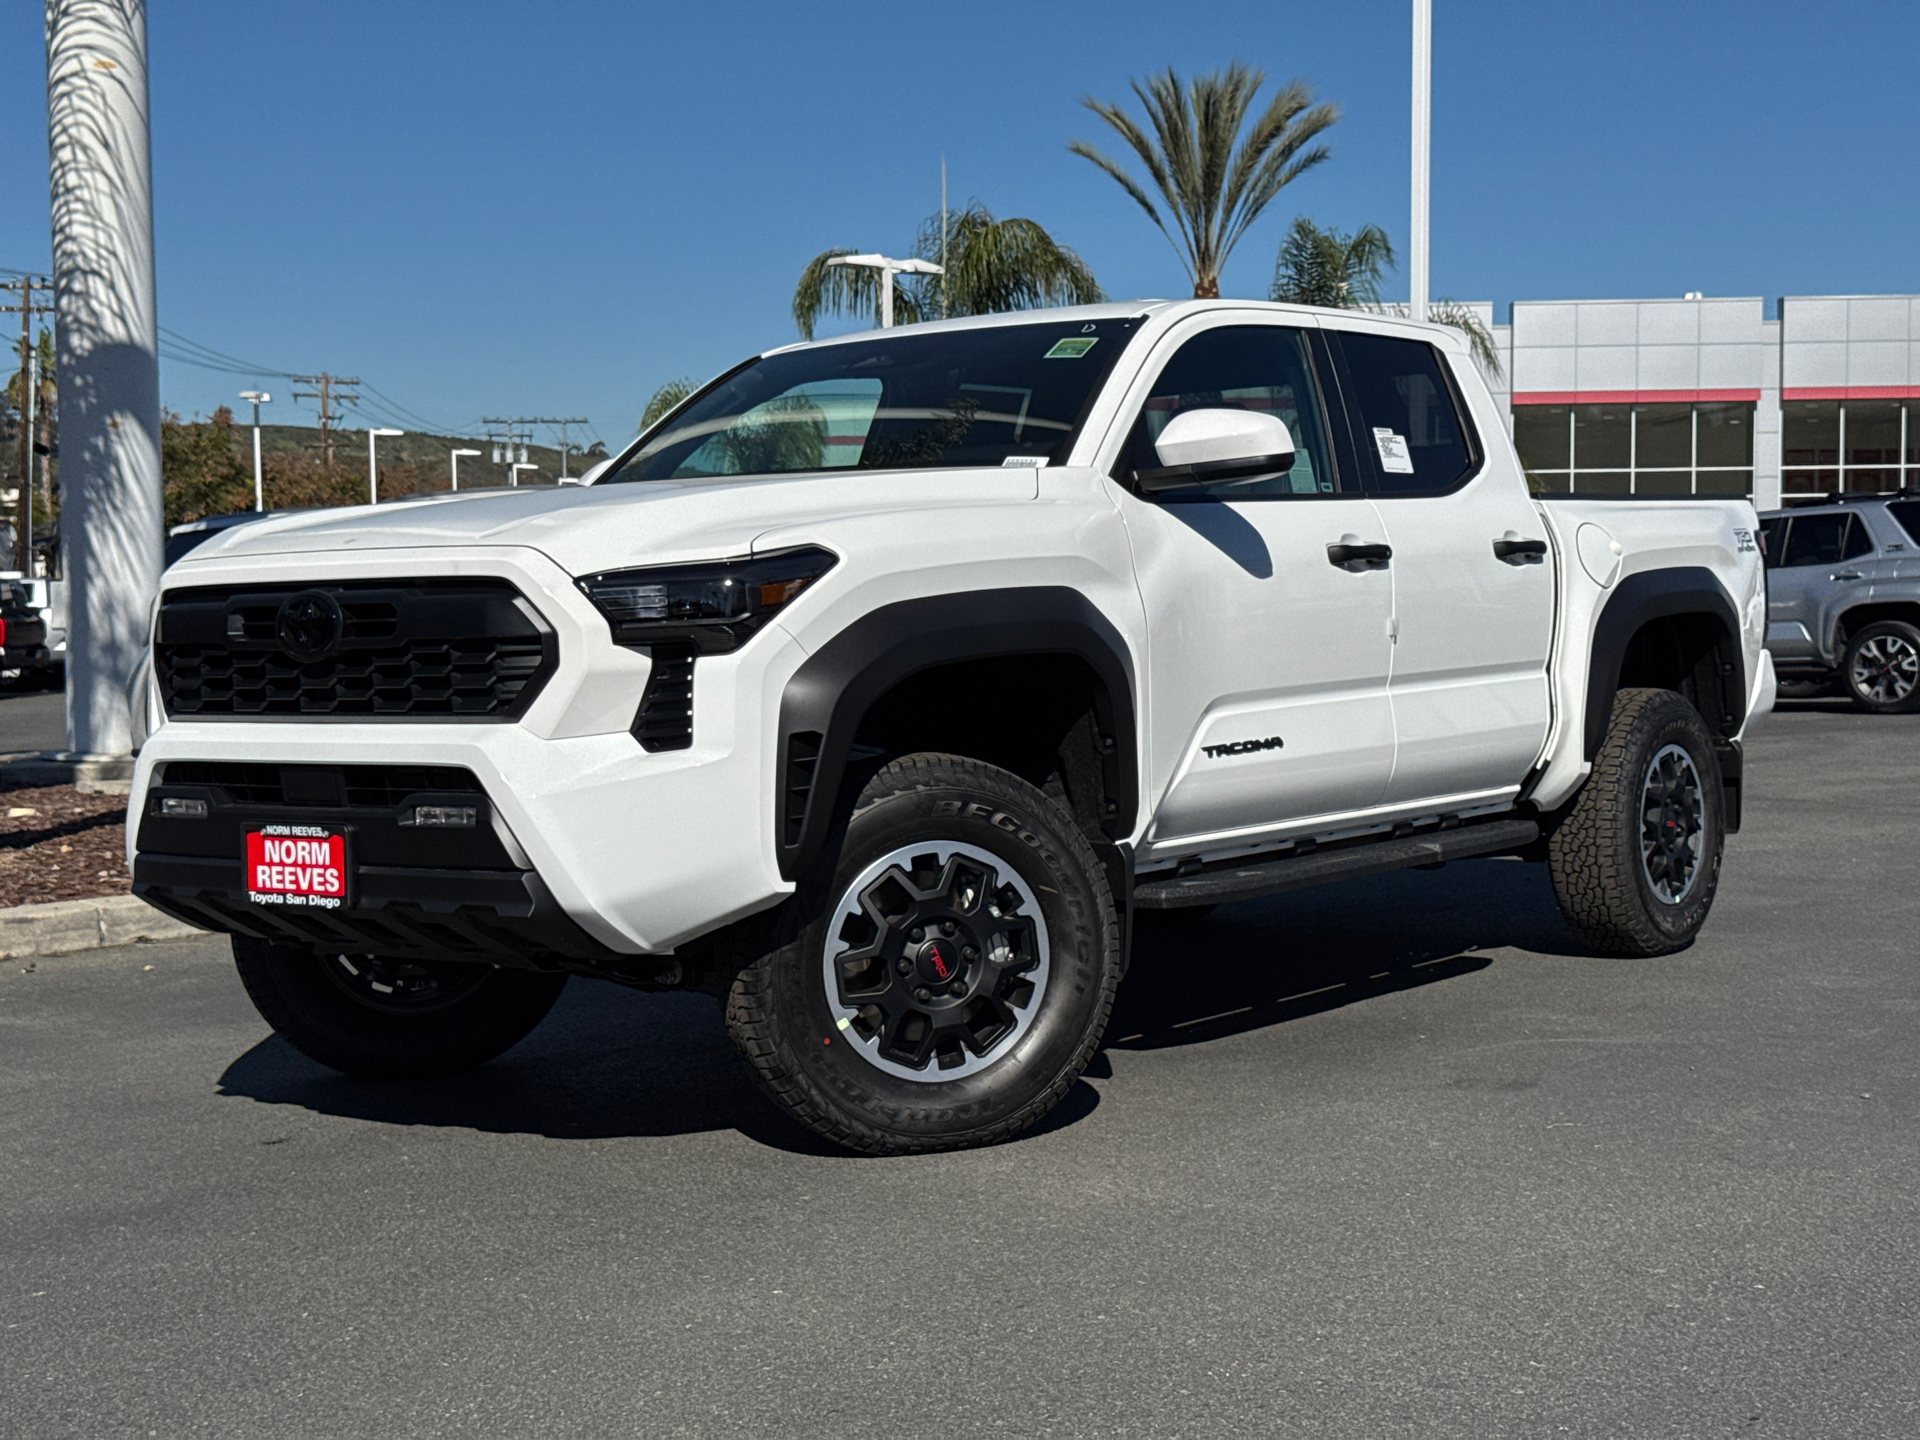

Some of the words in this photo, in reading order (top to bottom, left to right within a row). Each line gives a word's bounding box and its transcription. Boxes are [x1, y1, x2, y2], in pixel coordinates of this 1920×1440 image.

[1201, 736, 1284, 759] TACOMA
[266, 825, 290, 836] NORM
[291, 826, 323, 837] REEVES
[264, 840, 330, 866] NORM
[257, 865, 340, 892] REEVES
[248, 891, 284, 905] Toyota
[285, 893, 306, 905] San
[308, 895, 341, 909] Diego
[931, 800, 1092, 996] BFGoodrich
[930, 945, 948, 978] TRD
